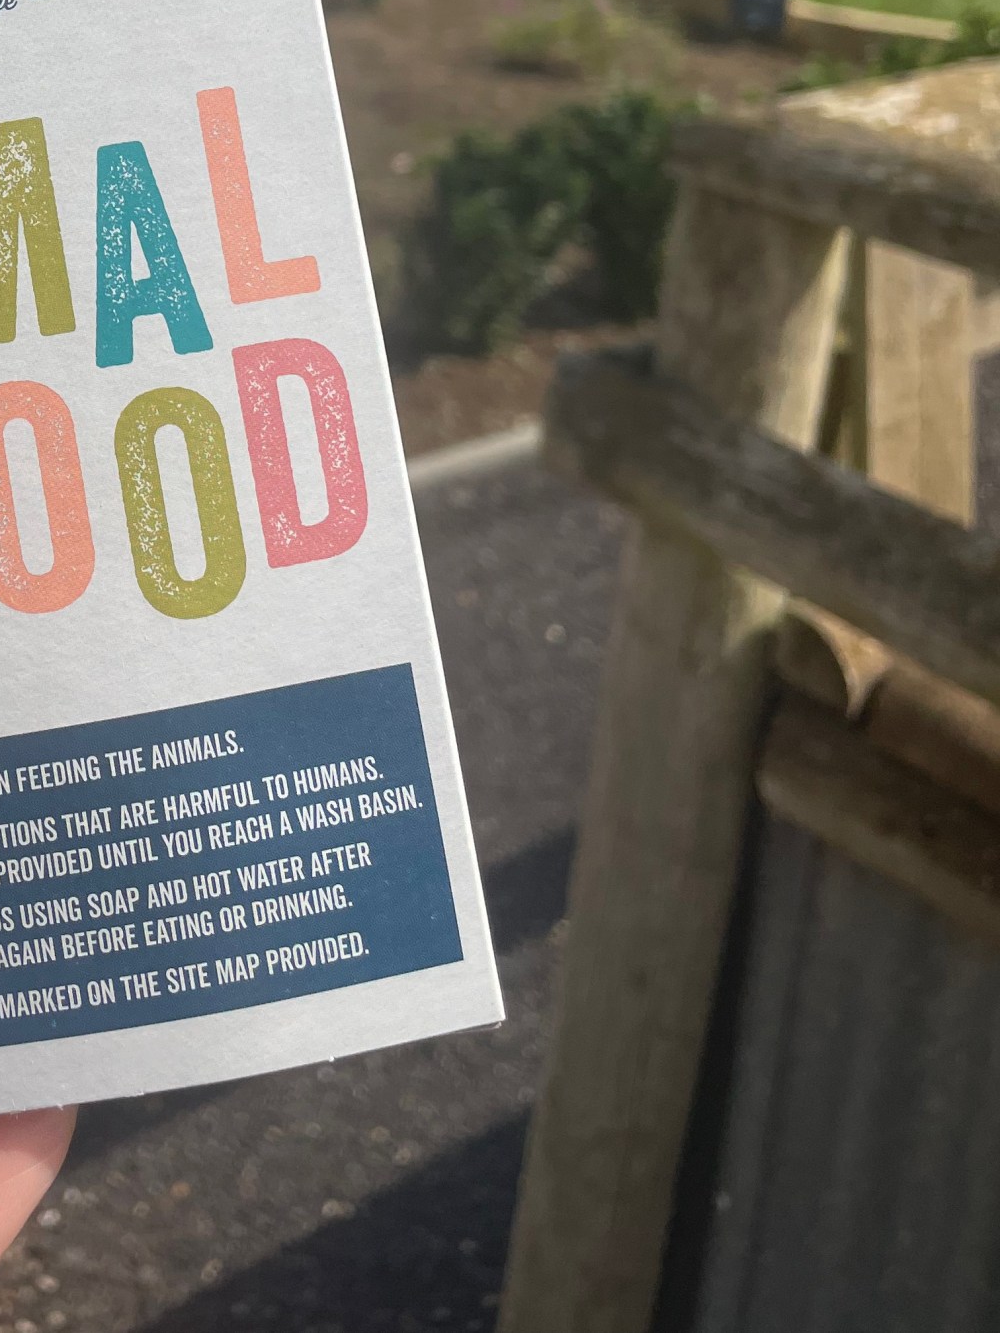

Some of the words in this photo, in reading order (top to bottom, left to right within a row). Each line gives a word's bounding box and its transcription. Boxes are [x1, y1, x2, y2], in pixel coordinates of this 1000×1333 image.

[16, 756, 101, 792] FEEDING
[105, 748, 146, 776] THE
[153, 730, 244, 769] ANIMALS.
[61, 807, 111, 838] THAT
[121, 800, 158, 829] ARE
[163, 781, 260, 821] HARMFUL
[262, 774, 289, 801] TO
[293, 756, 384, 796] HUMANS.
[98, 837, 158, 869] UNTIL
[162, 828, 202, 857] YOU
[208, 814, 273, 850] REACH
[280, 811, 293, 836] A
[295, 801, 354, 831] WASH
[358, 785, 423, 818] BASIN.
[20, 897, 82, 928] USING
[88, 888, 139, 918] SOAP
[148, 879, 187, 909] AND
[193, 870, 231, 900] HOT
[237, 856, 305, 891] WATER
[312, 842, 372, 877] AFTER
[61, 924, 138, 959] BEFORE
[143, 911, 215, 946] EATING
[220, 905, 247, 932] OR
[252, 884, 353, 926] DRINKING.
[87, 979, 115, 1005] ON
[120, 971, 161, 1000] THE
[166, 962, 211, 993] SITE
[215, 954, 259, 984] MAP
[266, 932, 369, 975] PROVIDED.
